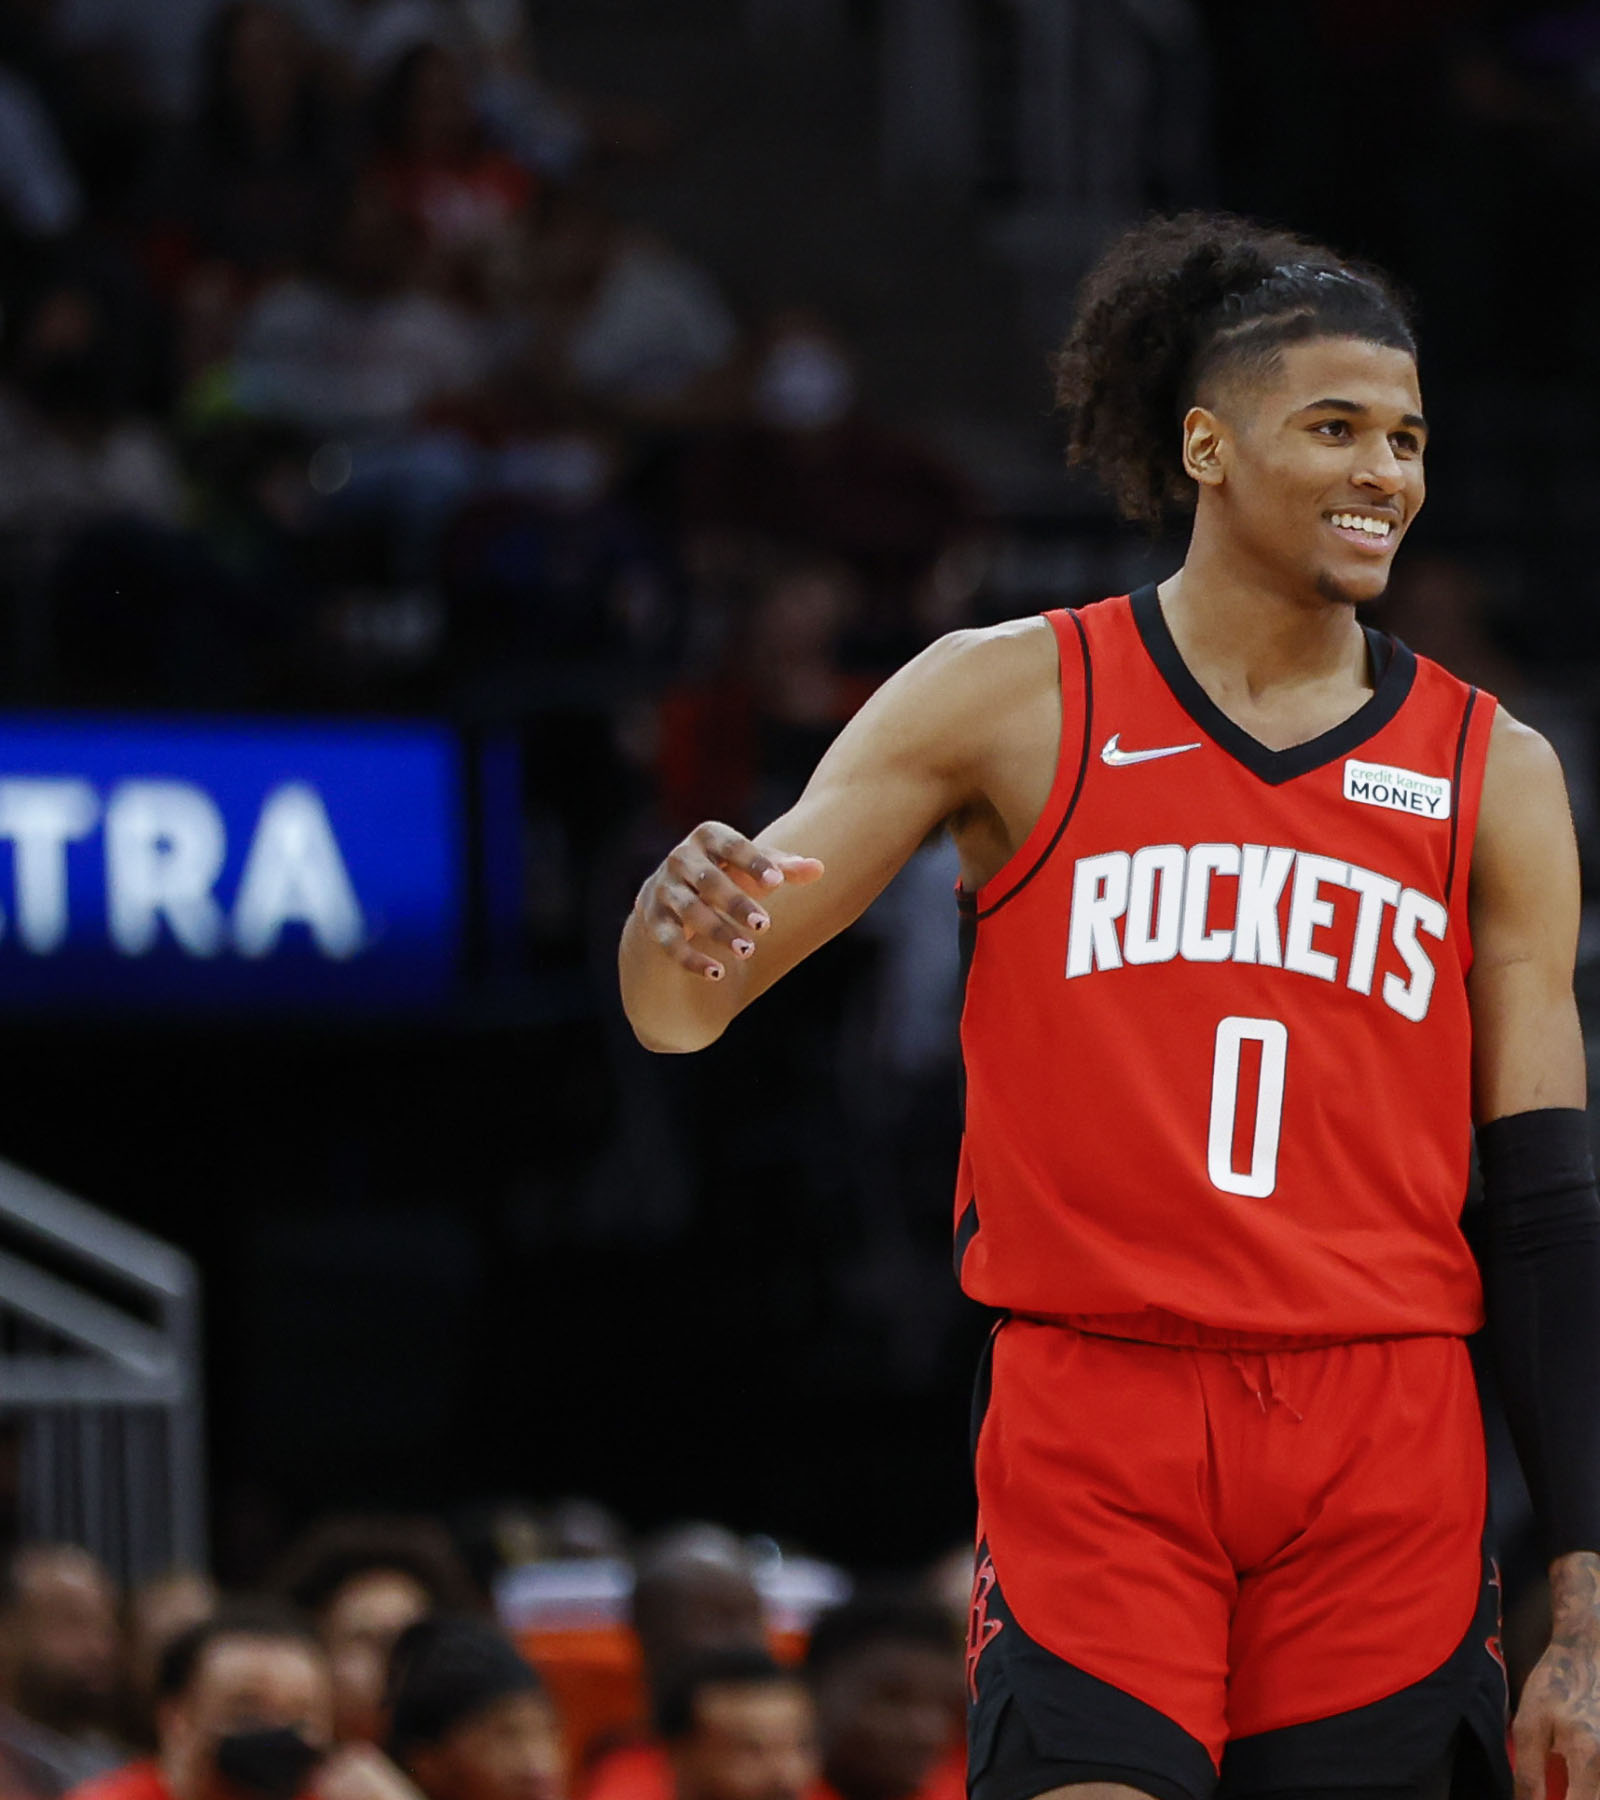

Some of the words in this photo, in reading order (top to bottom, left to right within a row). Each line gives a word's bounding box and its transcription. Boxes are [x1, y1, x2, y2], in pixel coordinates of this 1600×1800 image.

[0, 774, 366, 960] TRA
[1350, 766, 1393, 785] credit
[1396, 774, 1443, 796] karma
[1351, 780, 1441, 814] MONEY
[1065, 843, 1448, 1023] ROCKETS
[1207, 1015, 1288, 1199] 0
